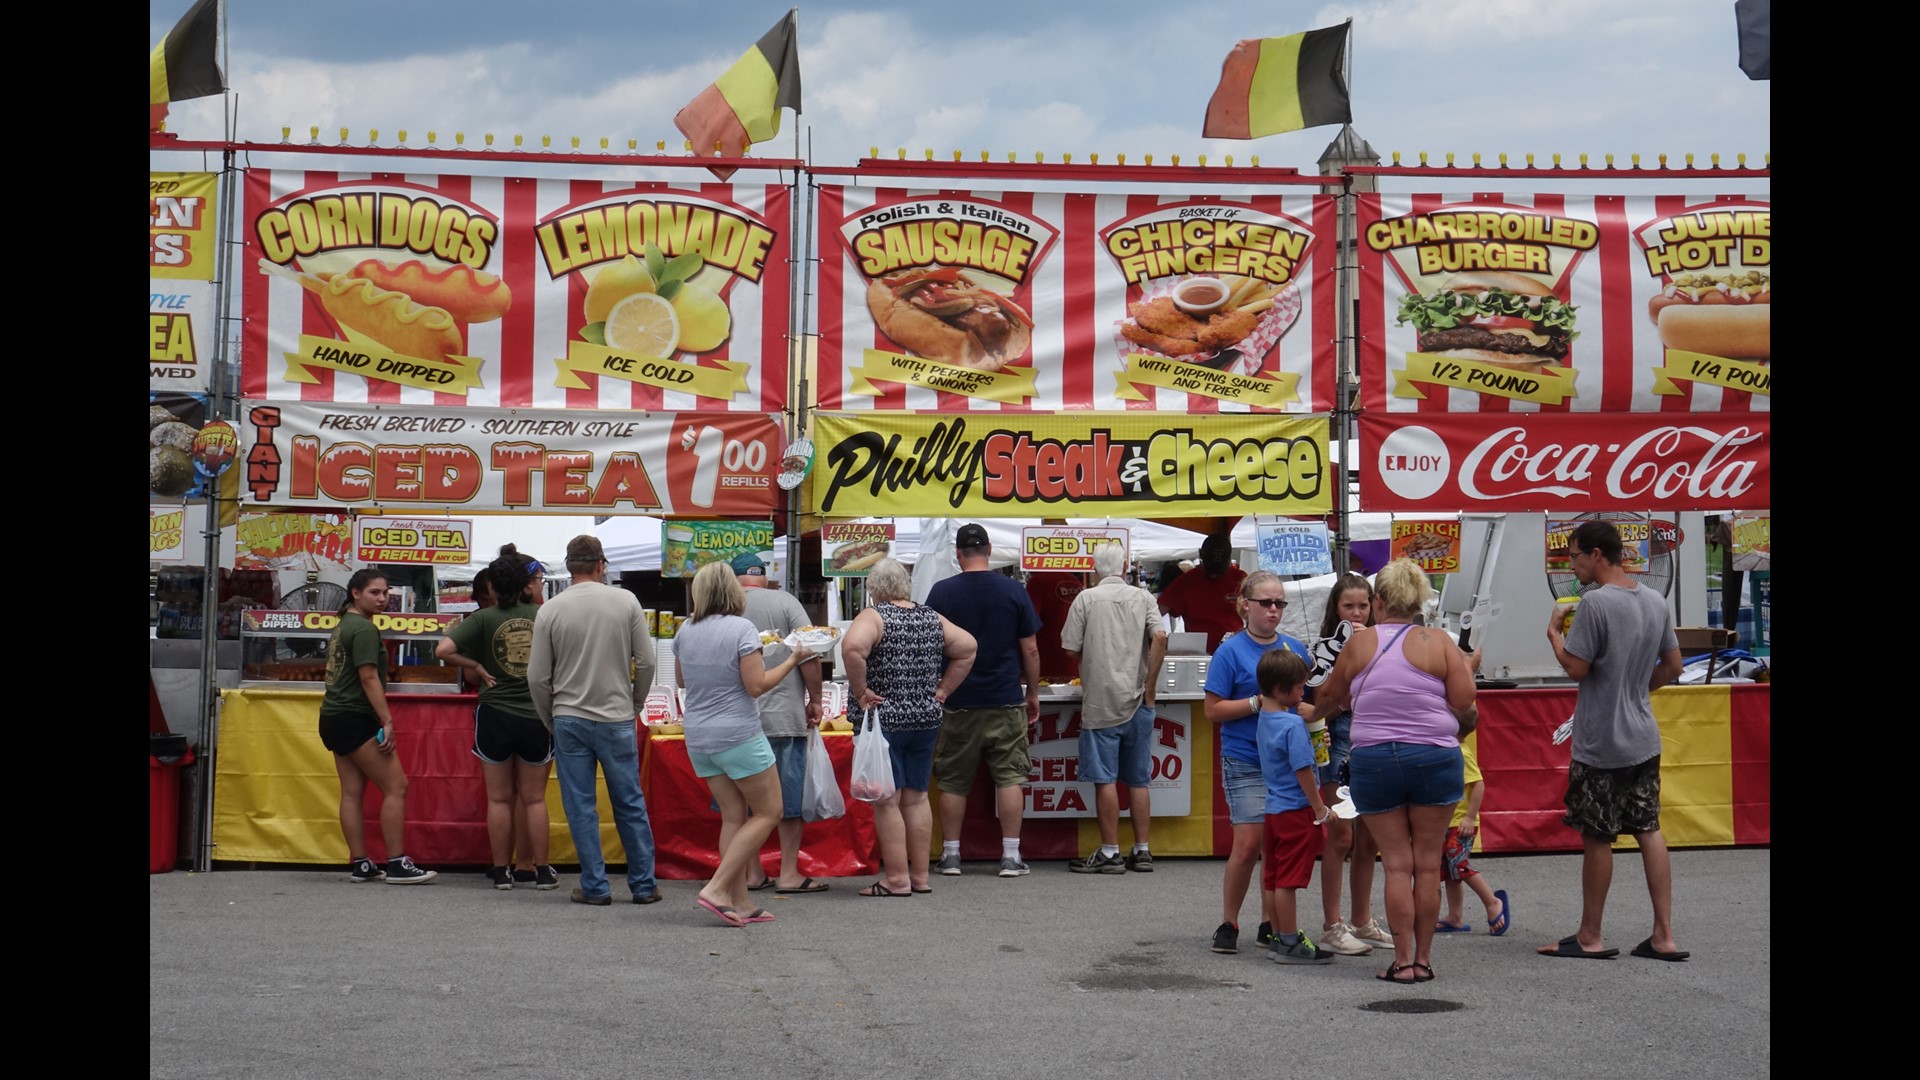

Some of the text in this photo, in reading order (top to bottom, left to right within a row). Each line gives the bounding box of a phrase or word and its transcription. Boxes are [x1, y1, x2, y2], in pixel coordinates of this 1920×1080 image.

[859, 202, 1031, 234] Polish & Italian
[1178, 208, 1241, 219] BASKET OF
[255, 192, 499, 270] CORN DOGS
[533, 199, 777, 285] LEMONADE
[1107, 218, 1309, 262] CHICKEN
[1365, 211, 1599, 253] CHARBROILED
[852, 217, 1039, 285] SAUSAGE
[1419, 240, 1553, 276] BURGER
[1645, 237, 1737, 277] HOT
[1119, 247, 1293, 286] FINGERS
[312, 345, 456, 385] HAND DIPPED
[603, 355, 694, 384] ICE COLD
[891, 356, 995, 386] WITH PEPPERS
[1138, 358, 1274, 394] WITH DIPPING SAUCE
[1431, 361, 1540, 395] 1/2 POUND
[1691, 360, 1770, 390] 1/4 POU
[911, 373, 978, 394] & ONIONS
[1172, 377, 1241, 398] AND FRIES
[318, 414, 639, 438] FRESH BREWED SOUTHERN STYLE
[247, 406, 282, 501] GIANT
[820, 416, 1324, 513] Philly Steak & Cheese
[290, 434, 663, 509] ICED TEA
[722, 476, 769, 488] REFILLS
[238, 514, 311, 547] CHICKEN
[363, 527, 467, 549] ICED TEA
[416, 522, 449, 530] Brewed
[694, 530, 774, 548] LEMONADE
[827, 534, 890, 544] SAUSAGE
[829, 525, 887, 534] ITALIAN
[1052, 529, 1108, 538] Fresh Brewed
[1392, 523, 1460, 541] FRENCH
[1733, 518, 1770, 553] CHIC
[361, 549, 430, 561] $1 REFILL
[1027, 537, 1079, 554] ICED
[1263, 533, 1324, 551] BOTTLED
[1270, 548, 1319, 562] WATER
[1025, 557, 1091, 569] $1 REFILL
[1395, 556, 1457, 570] IES
[265, 613, 299, 621] FRESH
[372, 614, 438, 634] Dogs
